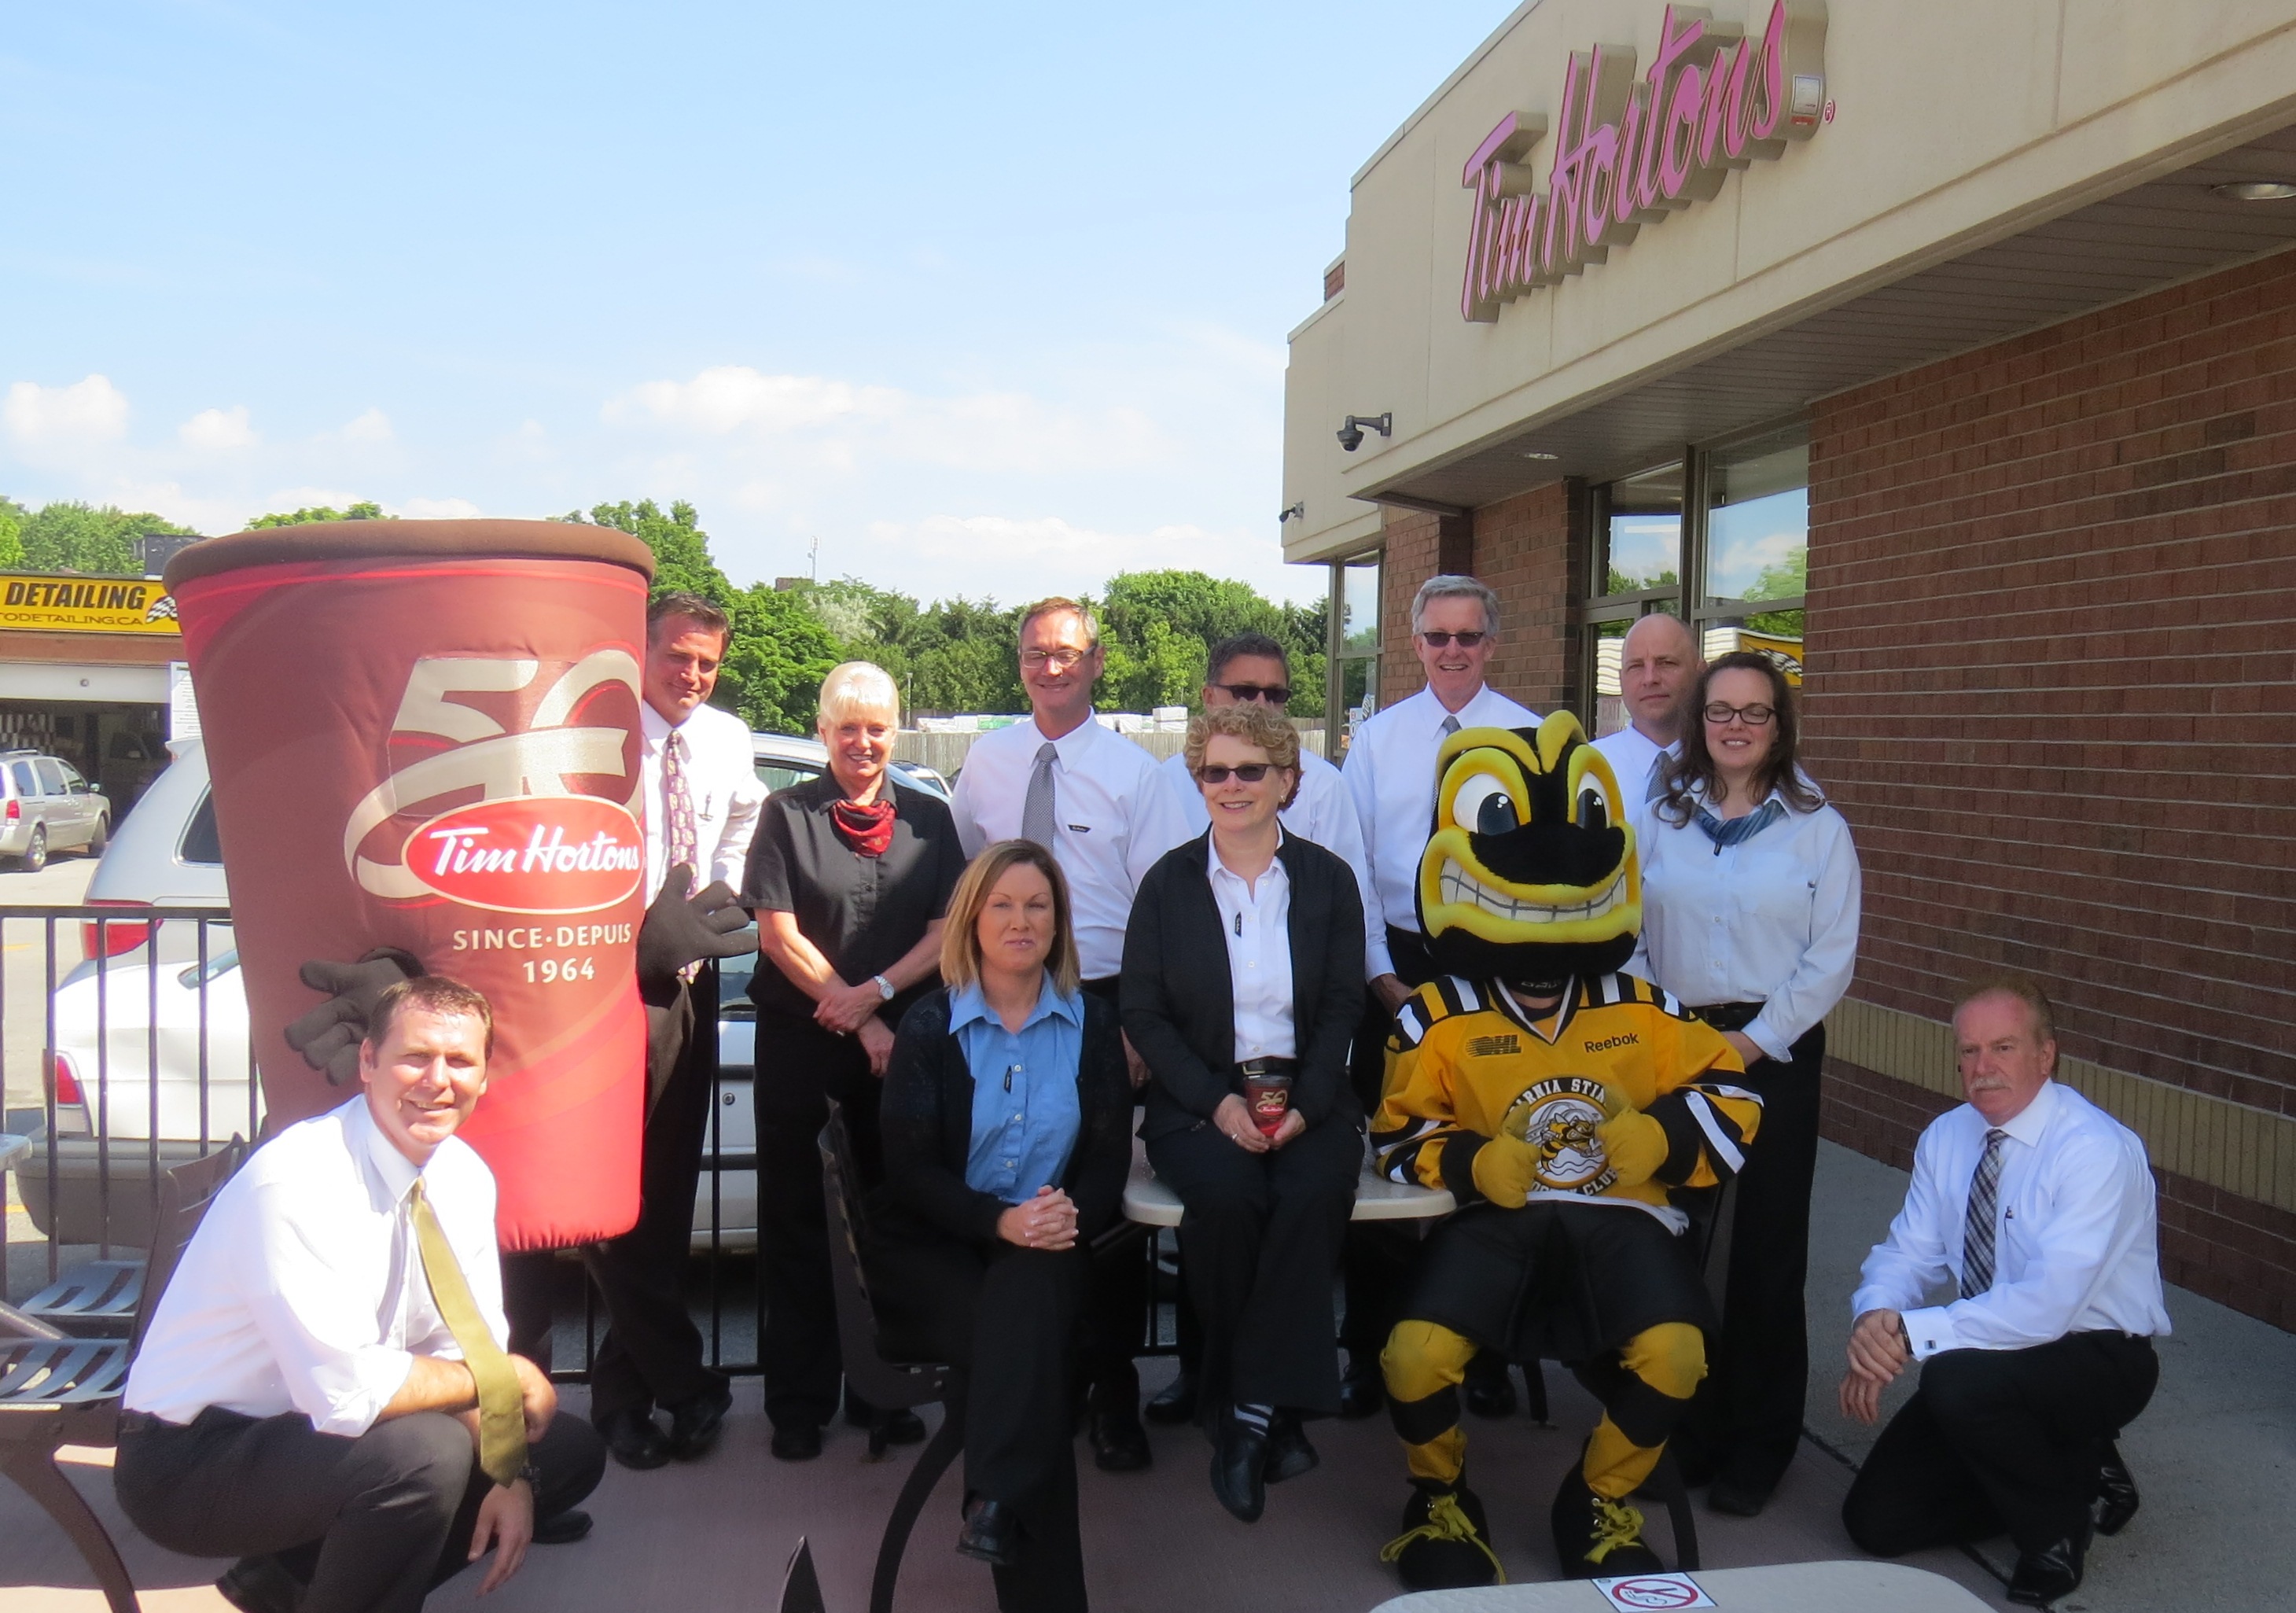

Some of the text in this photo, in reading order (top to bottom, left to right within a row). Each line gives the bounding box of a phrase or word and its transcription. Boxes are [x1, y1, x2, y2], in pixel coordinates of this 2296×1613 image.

[1461, 0, 1786, 322] Tim Hortons
[5, 581, 147, 610] DETAILING
[429, 823, 639, 877] Tim Hortons
[523, 956, 595, 983] 1964
[1584, 1033, 1639, 1053] Reebok
[1509, 1078, 1606, 1112] RNIA STIN
